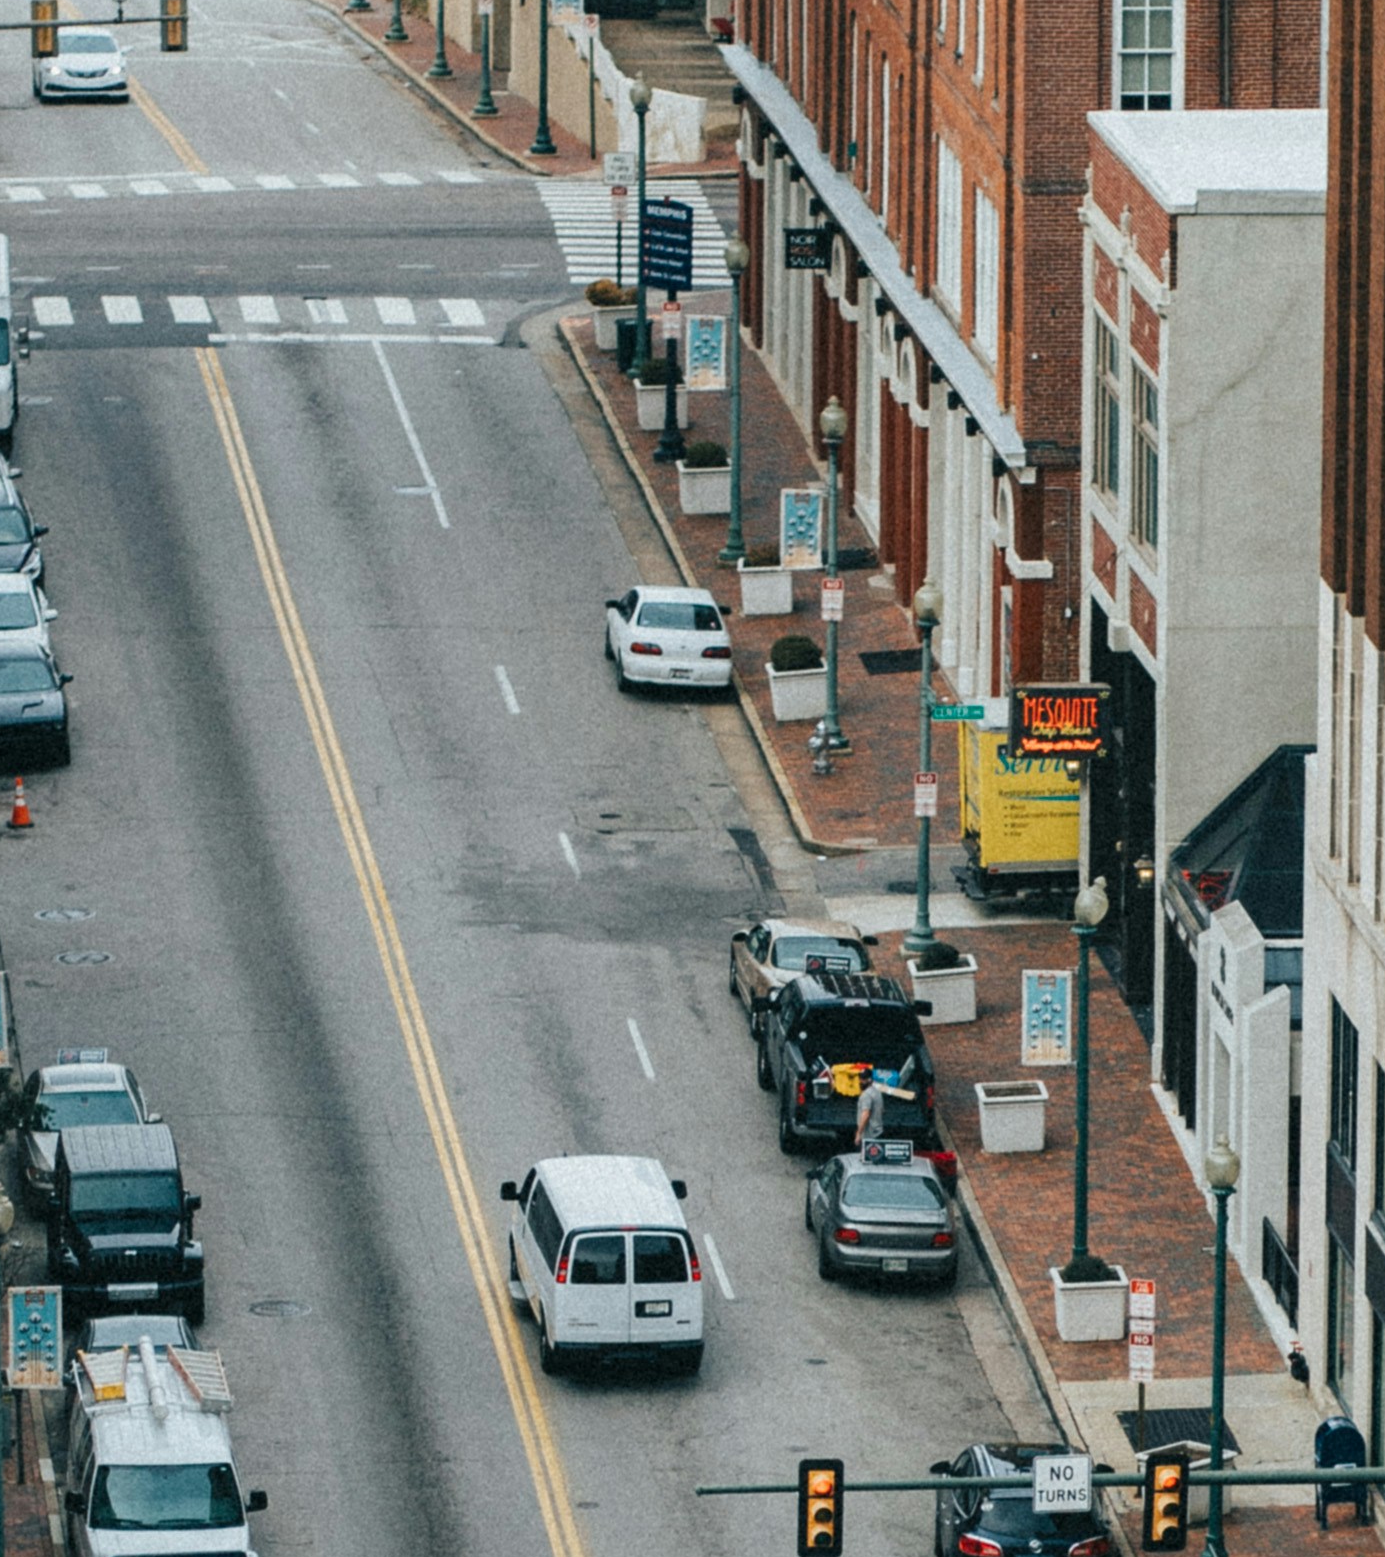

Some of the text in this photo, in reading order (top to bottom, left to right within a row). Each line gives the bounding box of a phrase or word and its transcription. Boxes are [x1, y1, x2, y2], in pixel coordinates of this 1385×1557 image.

[646, 205, 687, 220] MEMPHIS
[790, 256, 825, 267] SALON
[935, 707, 968, 717] CENTER
[1023, 697, 1098, 728] MESQUITE
[919, 774, 934, 784] NO
[1134, 1334, 1151, 1343] NO
[1049, 1466, 1074, 1481] NO
[1038, 1489, 1087, 1502] TURNS
